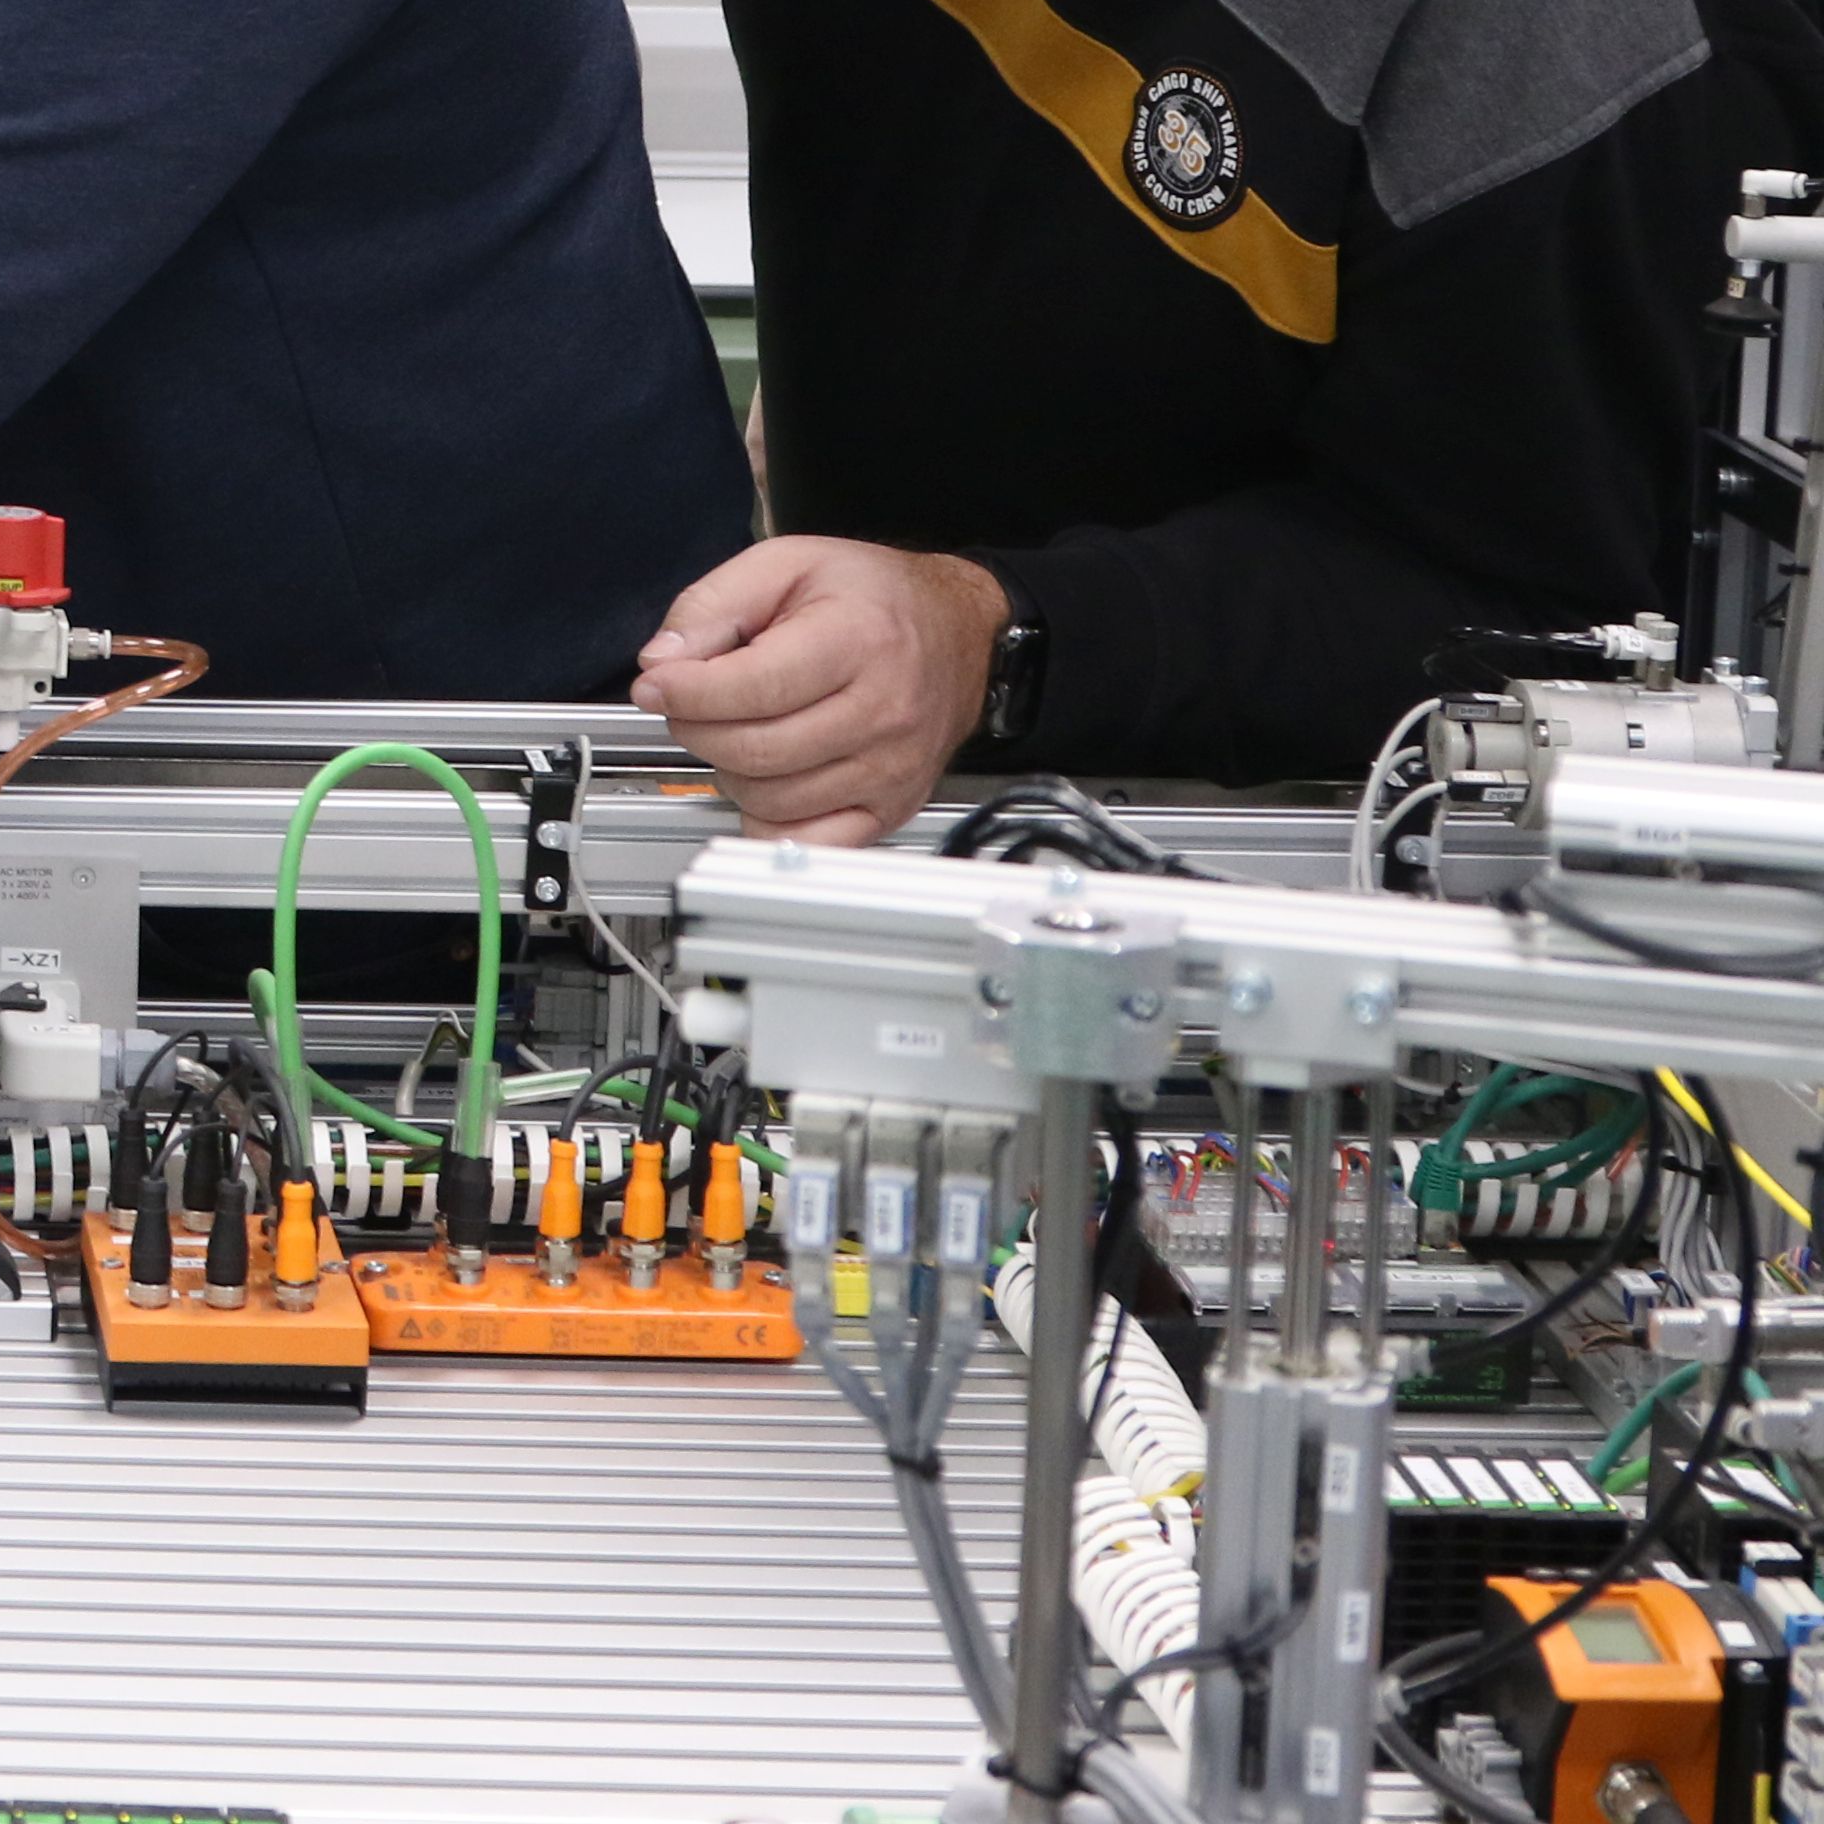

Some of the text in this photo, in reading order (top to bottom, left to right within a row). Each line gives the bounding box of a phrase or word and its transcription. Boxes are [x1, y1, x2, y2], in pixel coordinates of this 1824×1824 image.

[1148, 72, 1238, 178] CARGO SHIP TRAVEL
[1158, 110, 1212, 176] 35
[1134, 105, 1226, 216] NORDIC COAST CREW
[0, 868, 53, 877] AC MOTOR
[7, 951, 59, 968] -XZ1
